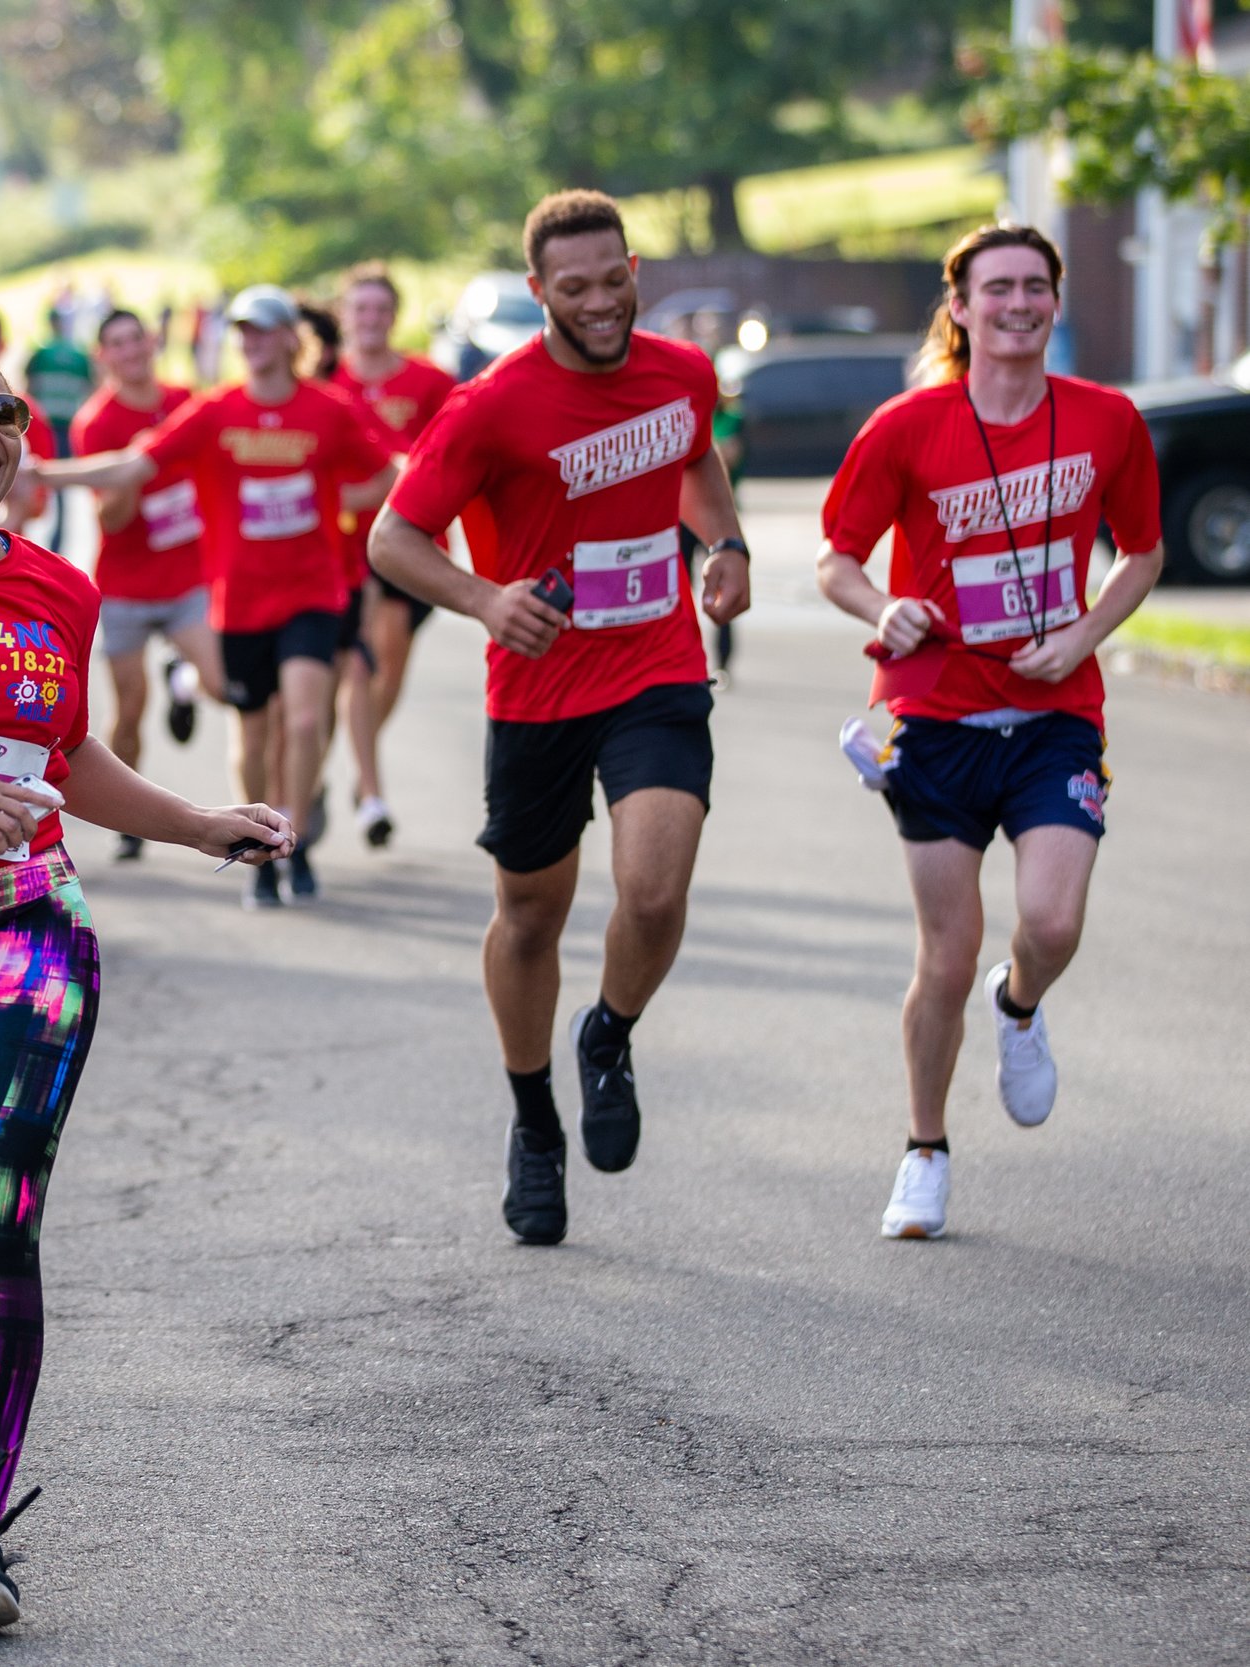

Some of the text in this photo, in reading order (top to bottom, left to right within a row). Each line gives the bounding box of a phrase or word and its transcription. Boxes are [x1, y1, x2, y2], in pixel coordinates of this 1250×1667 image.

[626, 567, 642, 604] 5
[1001, 578, 1038, 618] 65
[15, 703, 54, 723] MILE
